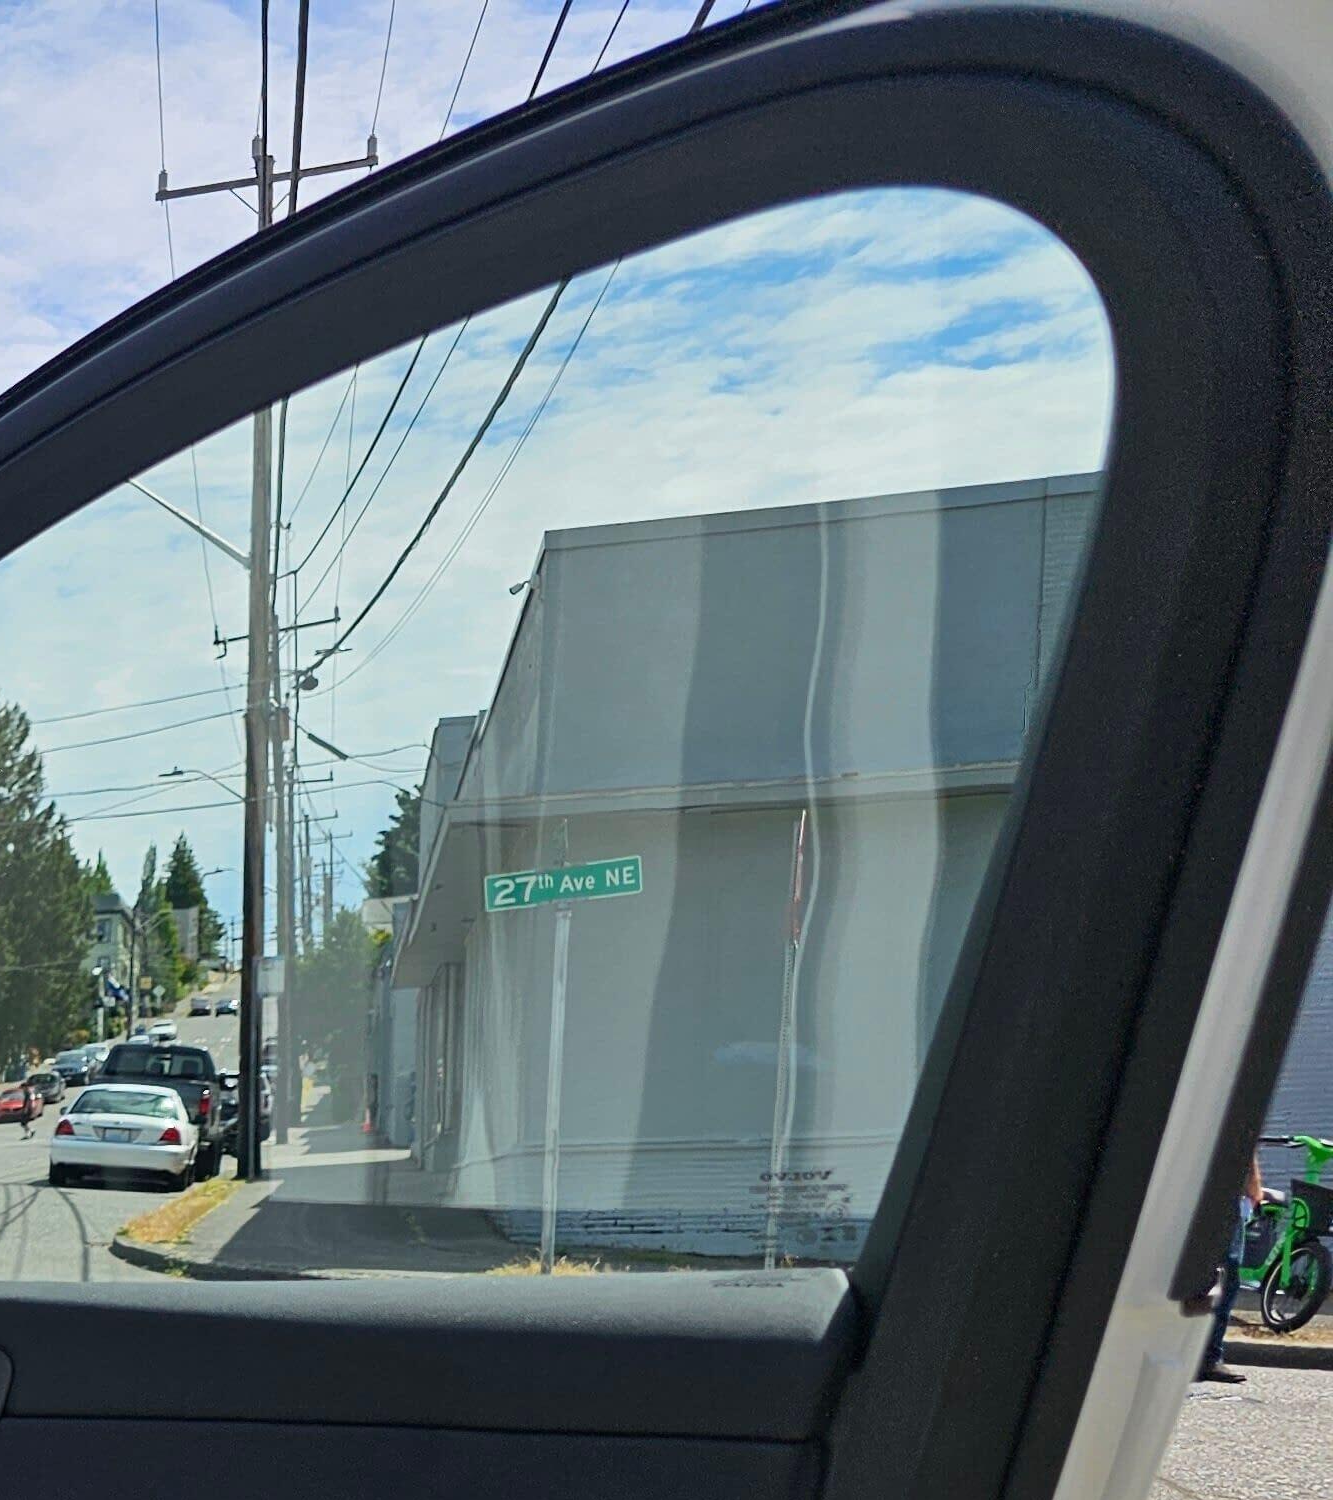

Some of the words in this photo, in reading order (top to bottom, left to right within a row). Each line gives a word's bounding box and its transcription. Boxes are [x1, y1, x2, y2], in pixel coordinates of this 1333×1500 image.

[493, 873, 554, 906] 27th
[559, 874, 595, 893] Ave
[605, 865, 636, 887] NE
